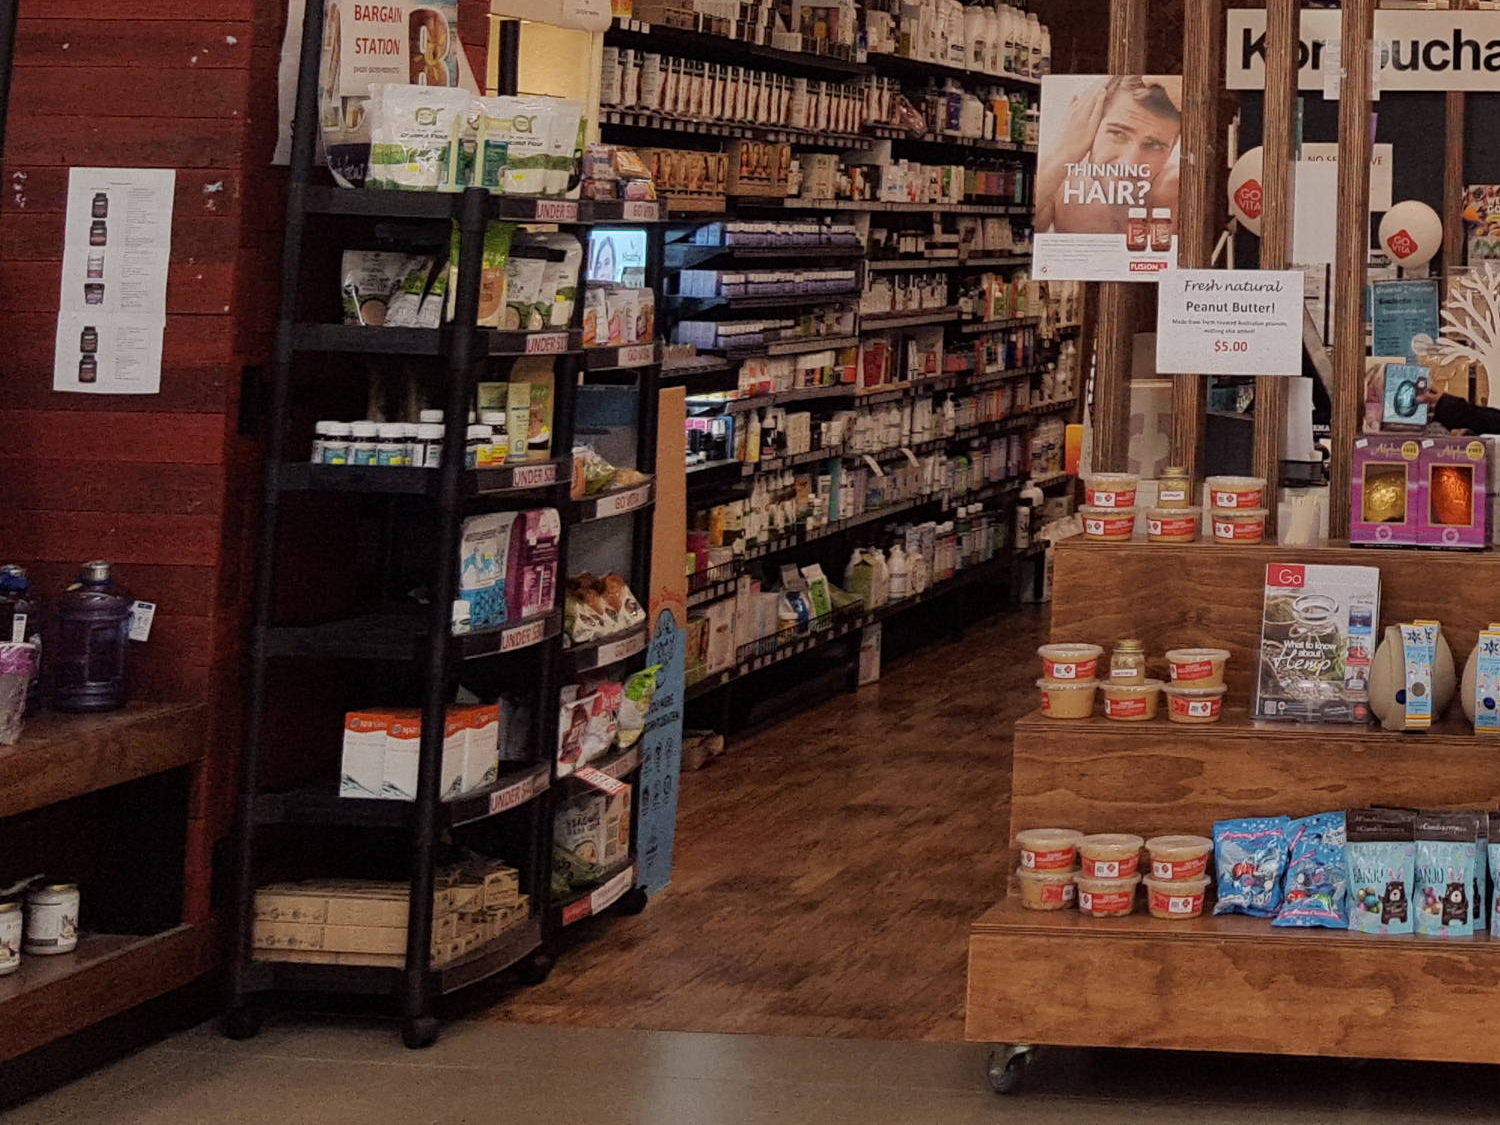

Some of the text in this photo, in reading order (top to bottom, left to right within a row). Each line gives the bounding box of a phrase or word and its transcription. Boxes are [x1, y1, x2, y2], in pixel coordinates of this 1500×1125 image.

[354, 4, 402, 23] BARGAIN
[355, 37, 401, 56] STATION
[1064, 163, 1151, 178] THINNING
[1063, 181, 1151, 205] HAIR?
[1240, 188, 1261, 201] GO
[537, 203, 564, 219] UNDER
[1393, 235, 1410, 247] GO
[1391, 244, 1411, 256] VITA
[1130, 262, 1159, 271] FUSION
[1184, 279, 1284, 293] Fresh natural
[1186, 301, 1276, 314] Peanut Butter!
[528, 338, 555, 353] UNDER
[1214, 340, 1248, 353] $5.00
[514, 468, 543, 486] UNDER
[1279, 569, 1302, 584] Go
[502, 627, 531, 650] UNDER
[1283, 639, 1337, 651] What to know
[1297, 649, 1322, 658] about
[1273, 649, 1331, 676] Hemp
[492, 789, 520, 811] UNDER
